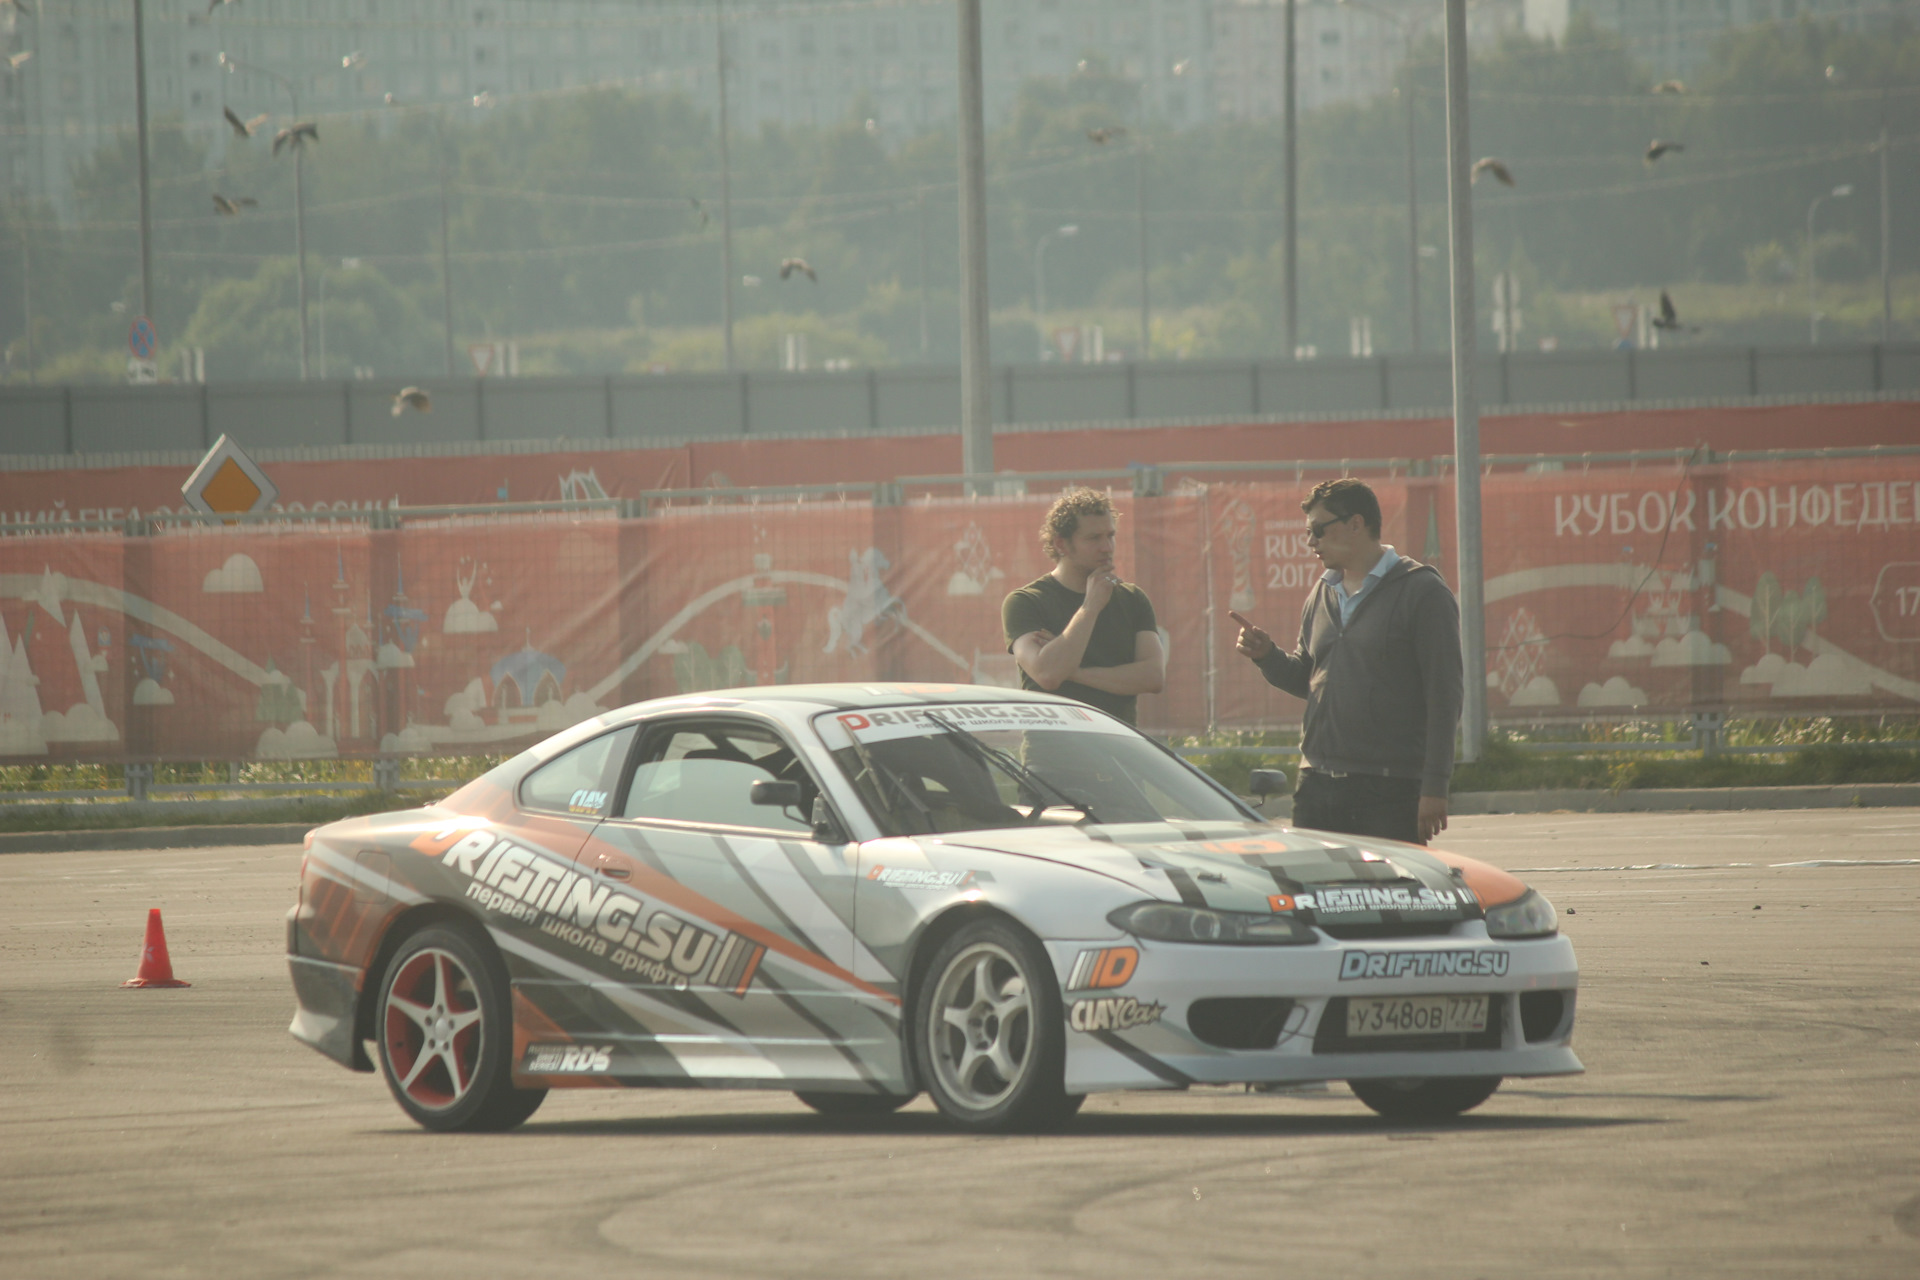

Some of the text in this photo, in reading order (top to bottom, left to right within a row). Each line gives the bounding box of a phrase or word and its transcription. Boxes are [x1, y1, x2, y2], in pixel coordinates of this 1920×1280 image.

[1555, 490, 1697, 537] КУБОК
[1265, 533, 1312, 558] RUS
[1267, 562, 1318, 589] 2017
[836, 706, 1060, 731] DRIFTING.SU
[1267, 887, 1457, 912] DRIFTING.SU
[464, 880, 689, 991] первая школа дрифта
[1338, 949, 1510, 982] DRIFTING.SU
[559, 1045, 615, 1072] RDS
